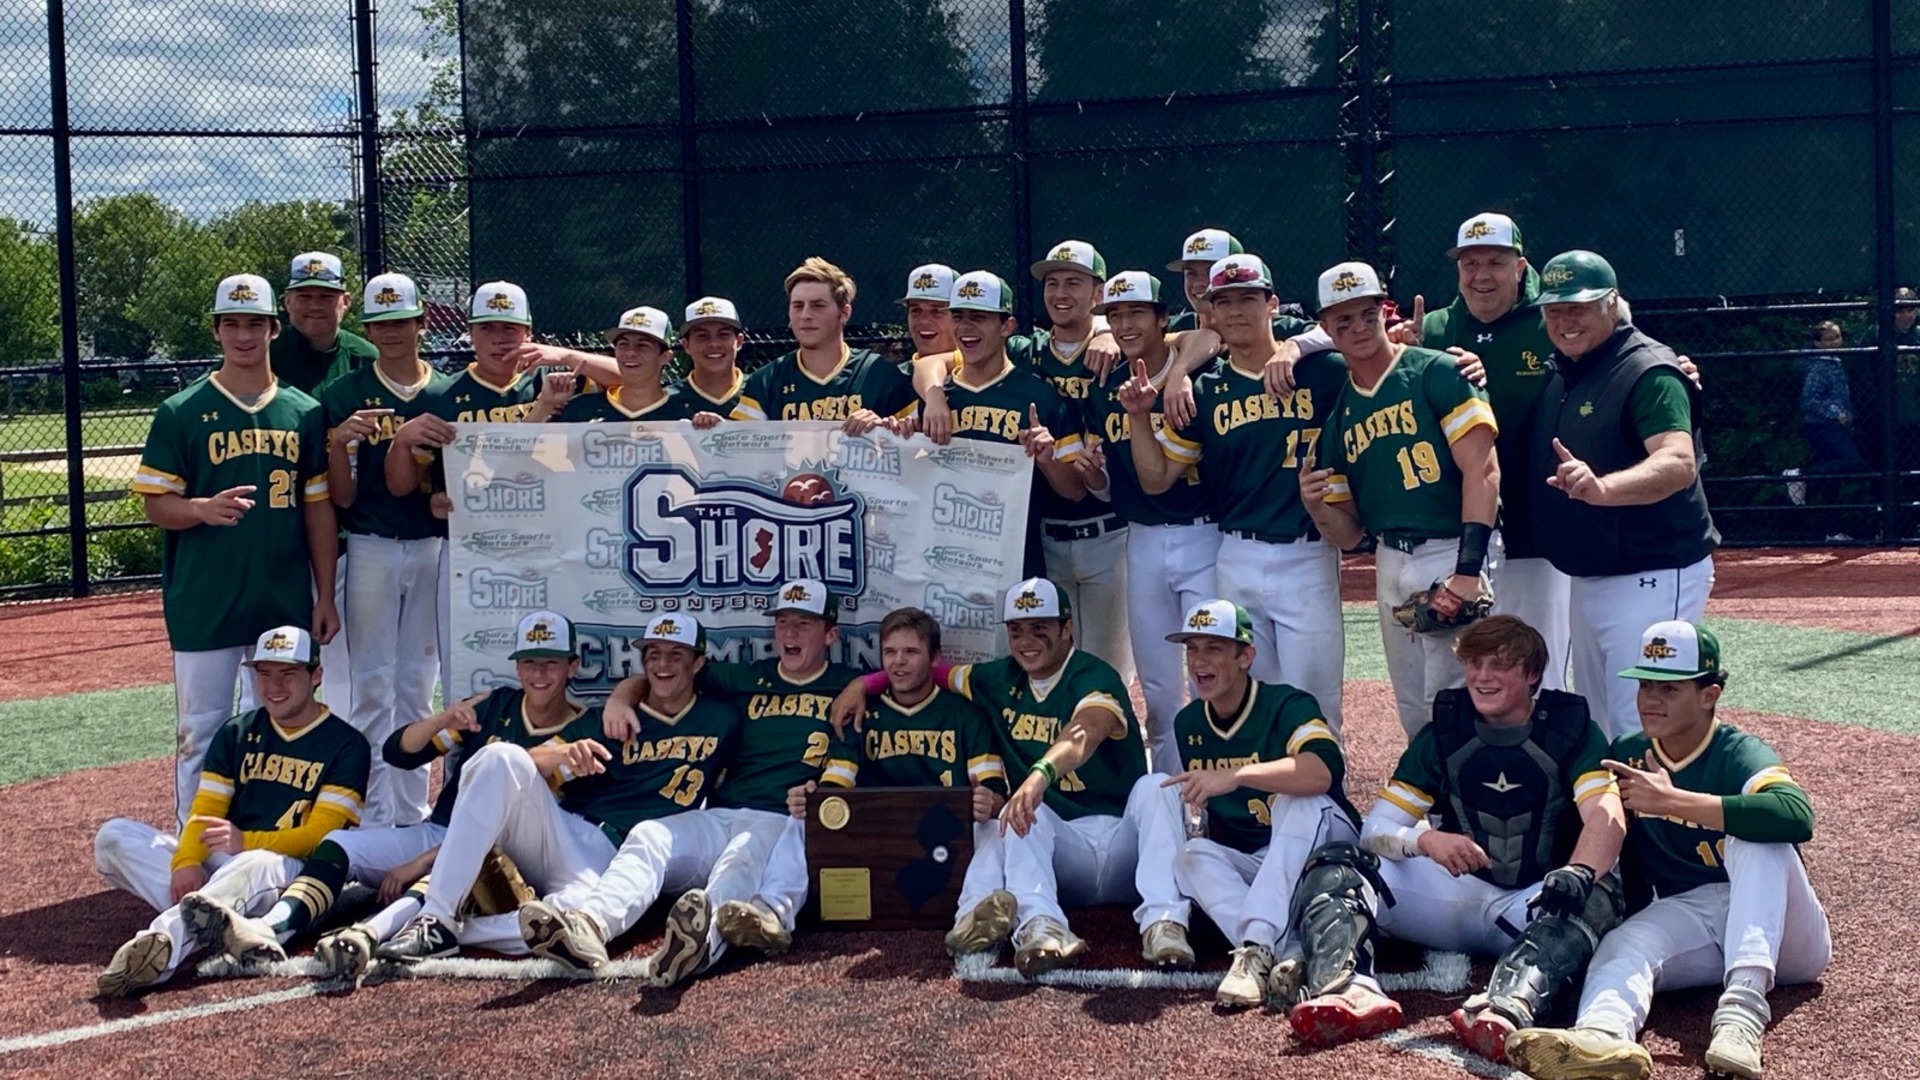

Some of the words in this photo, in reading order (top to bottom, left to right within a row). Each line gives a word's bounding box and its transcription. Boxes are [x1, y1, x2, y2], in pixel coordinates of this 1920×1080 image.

[950, 403, 1022, 441] ASEYS
[1214, 388, 1314, 436] CASEYS
[1344, 400, 1418, 464] CASEYS
[208, 429, 300, 465] CASEYS
[1282, 427, 1322, 468] 17
[1397, 441, 1441, 490] 19
[464, 472, 545, 512] SHORE
[932, 483, 1004, 536] SHORE
[630, 471, 855, 586] SHORE
[695, 507, 736, 518] THE
[470, 567, 548, 609] SHORE
[638, 595, 858, 613] CONFERE
[749, 694, 833, 720] CASEY
[622, 736, 718, 765] CASEYS
[866, 730, 956, 763] CASEYS
[240, 752, 325, 792] CASEYS
[659, 765, 704, 806] 13
